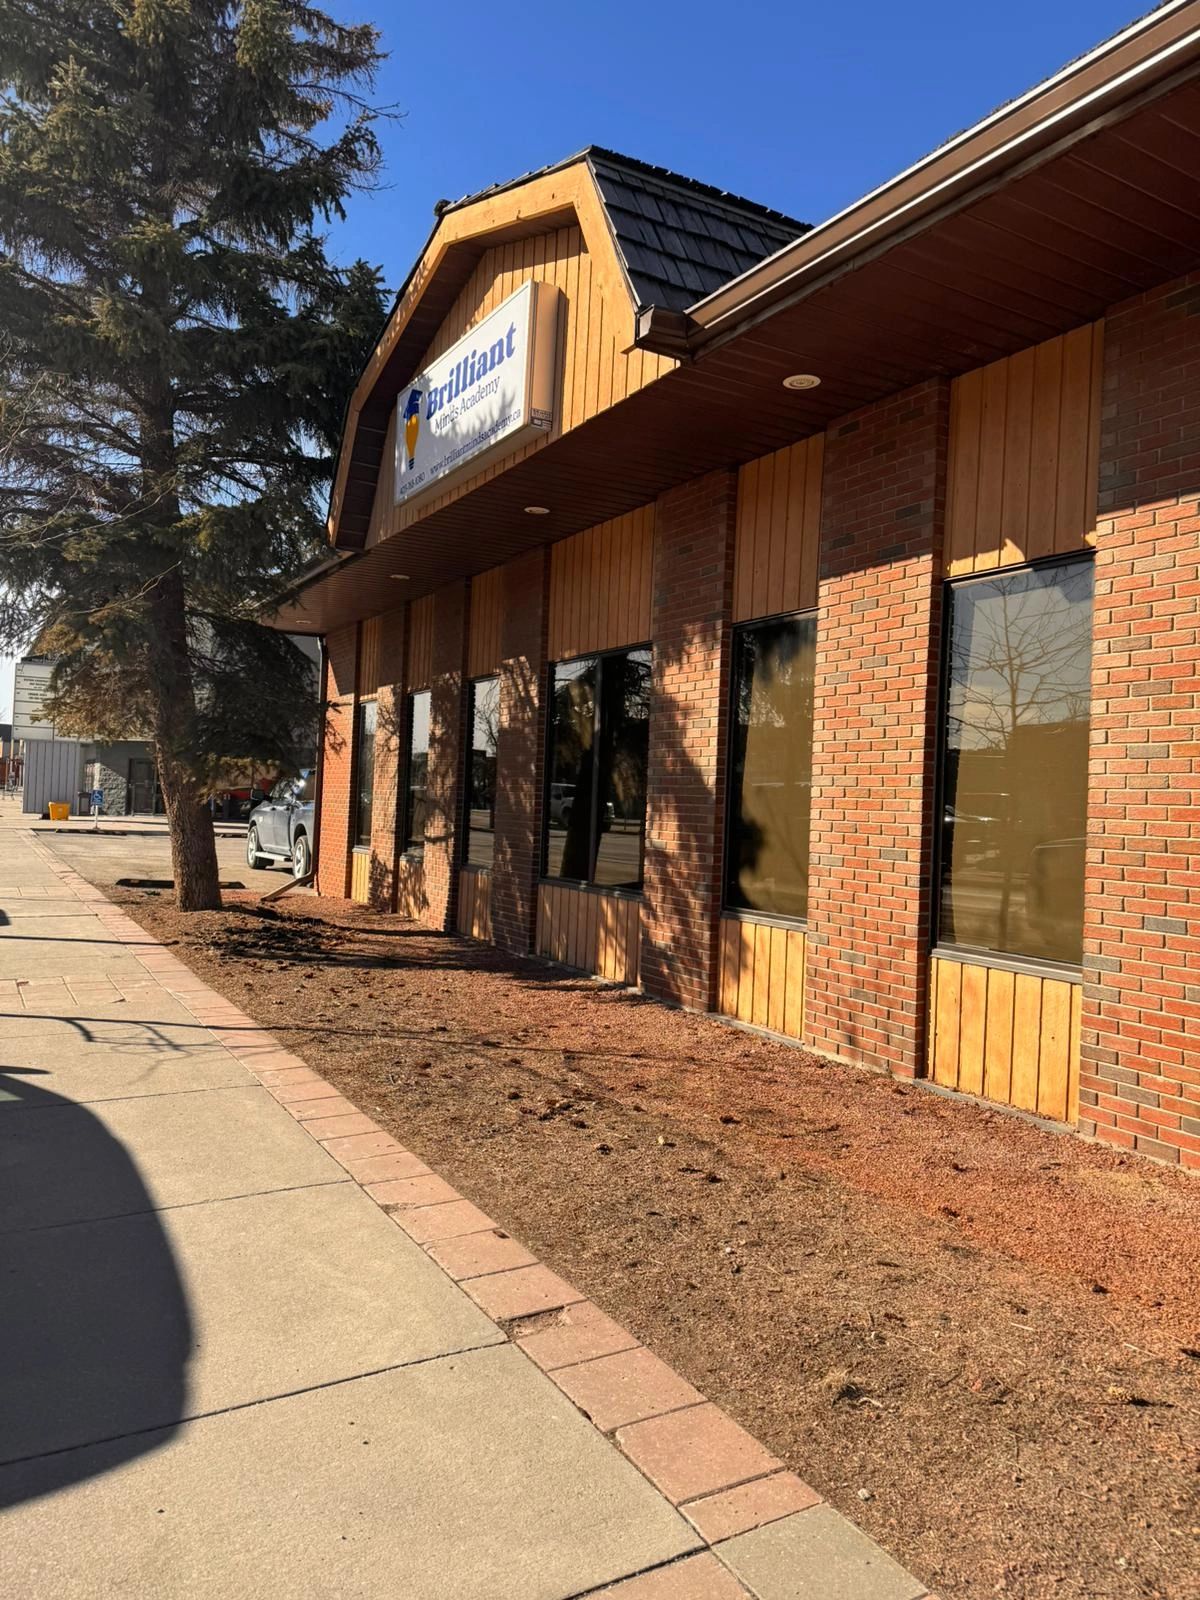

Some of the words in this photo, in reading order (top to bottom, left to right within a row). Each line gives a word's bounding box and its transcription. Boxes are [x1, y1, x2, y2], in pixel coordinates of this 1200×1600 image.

[426, 321, 517, 420] Brilliant
[434, 404, 459, 434] Minds
[460, 376, 500, 416] Academy
